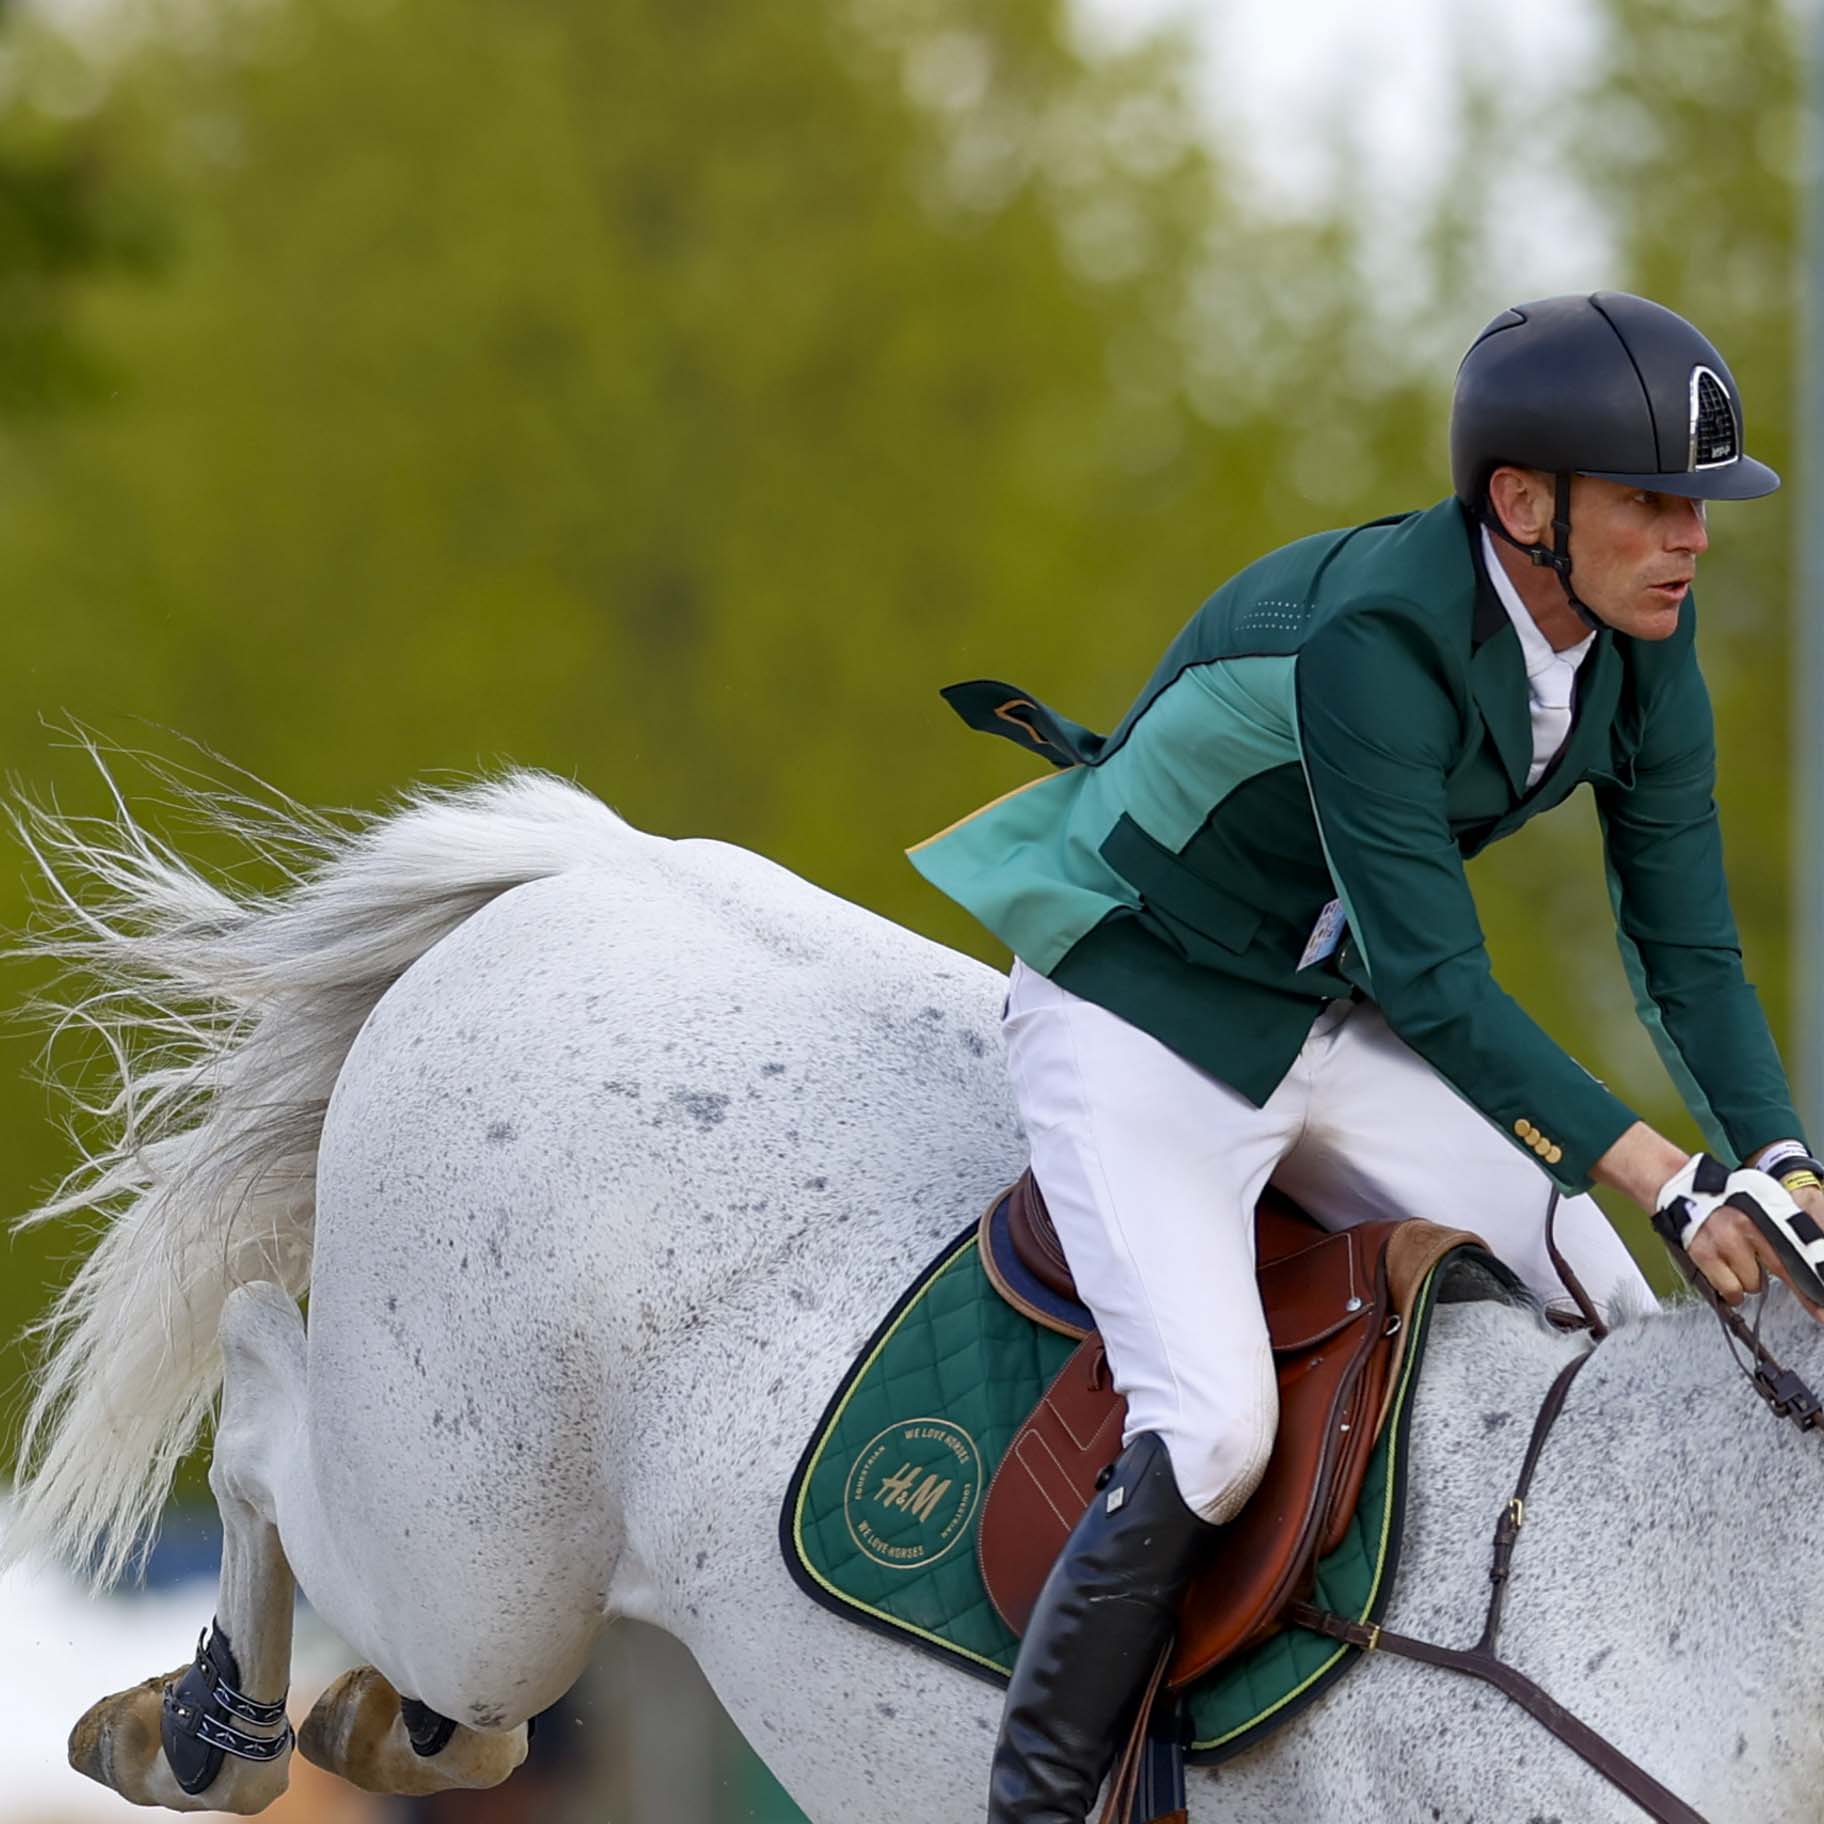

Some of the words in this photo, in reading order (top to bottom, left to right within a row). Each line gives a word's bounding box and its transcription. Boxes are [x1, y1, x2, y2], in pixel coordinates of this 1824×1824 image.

[905, 1428, 920, 1439] WE
[921, 1428, 946, 1441] LOVE
[873, 1462, 952, 1523] H&M
[858, 1520, 872, 1537] WE
[868, 1535, 889, 1554] LOVE
[887, 1545, 925, 1559] HORSES
